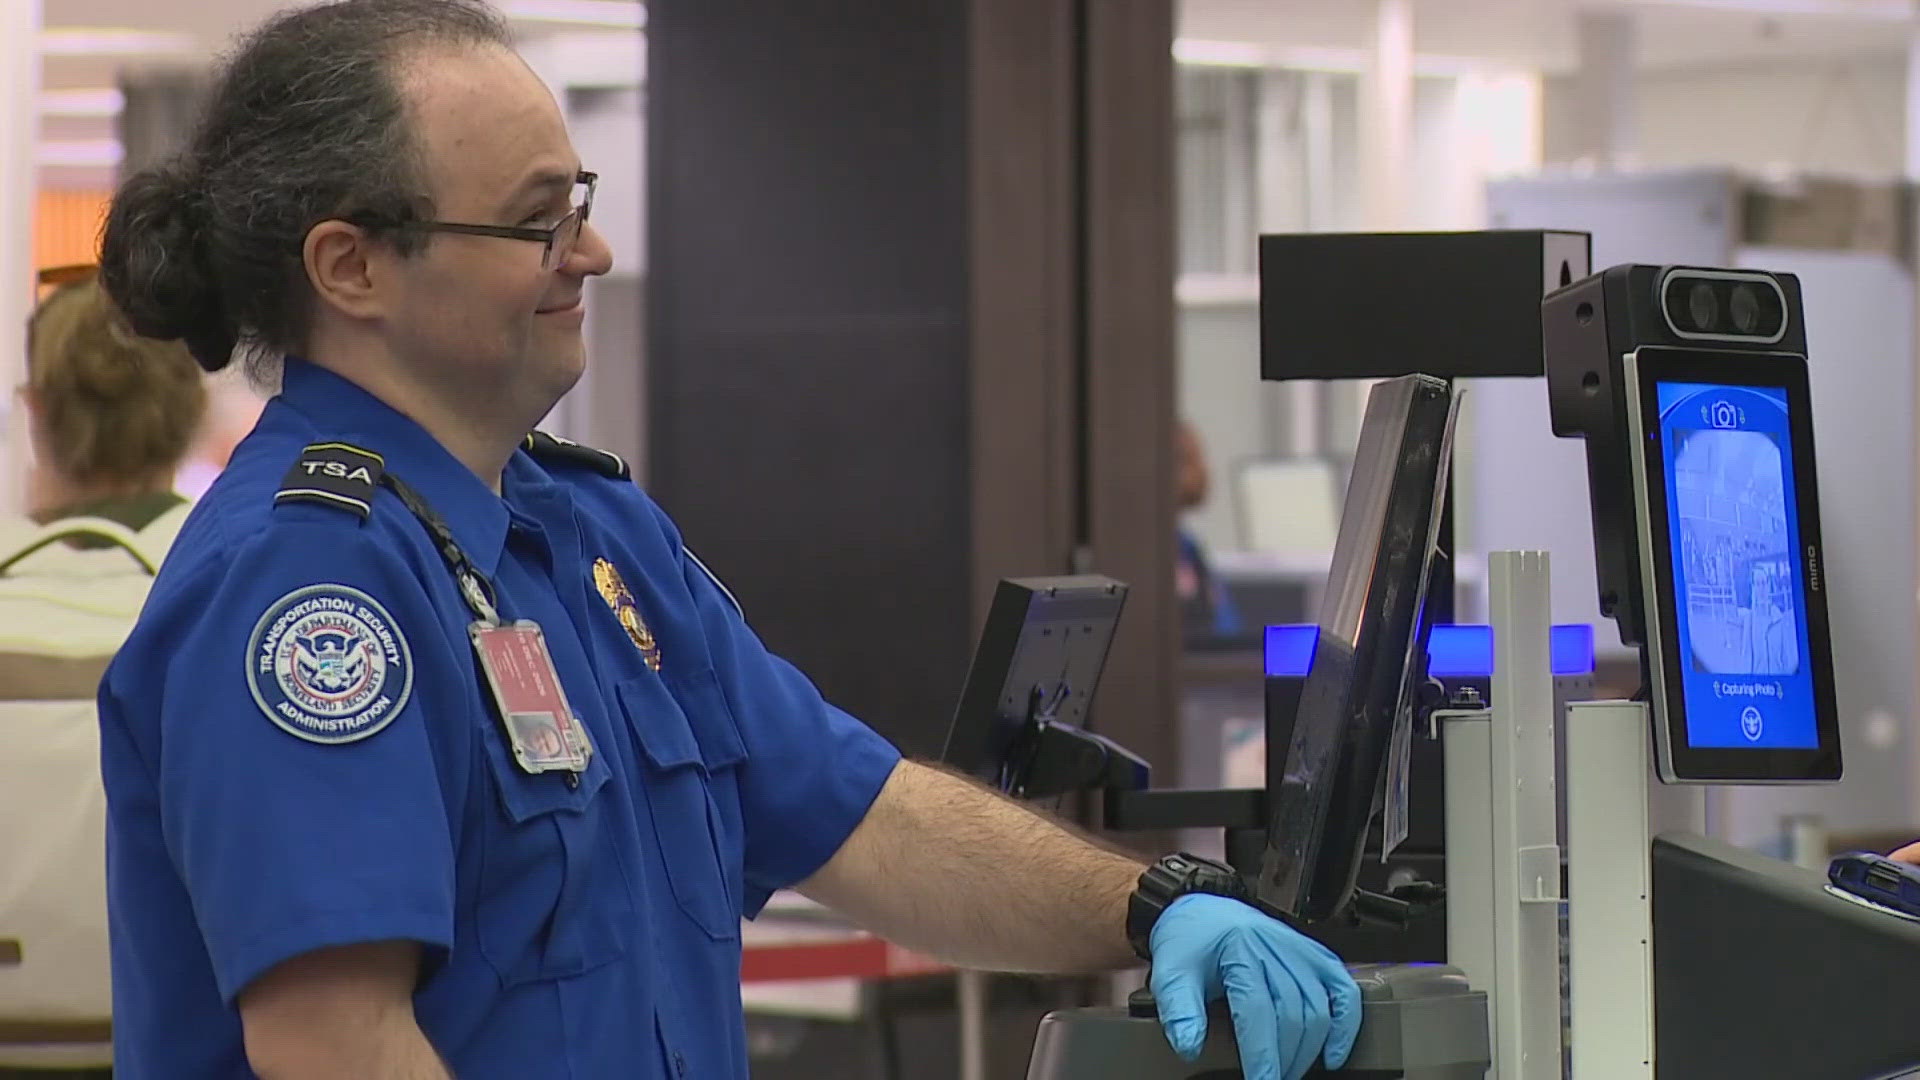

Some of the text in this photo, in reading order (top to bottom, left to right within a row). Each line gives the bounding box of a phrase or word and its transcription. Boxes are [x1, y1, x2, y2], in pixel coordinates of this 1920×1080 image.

[302, 461, 372, 485] TSA
[1807, 545, 1819, 591] mimo
[260, 598, 401, 675] TRANSPORTATION SECURITY
[1722, 683, 1776, 697] Capturing Photo
[276, 695, 391, 732] ADMINISTRATION
